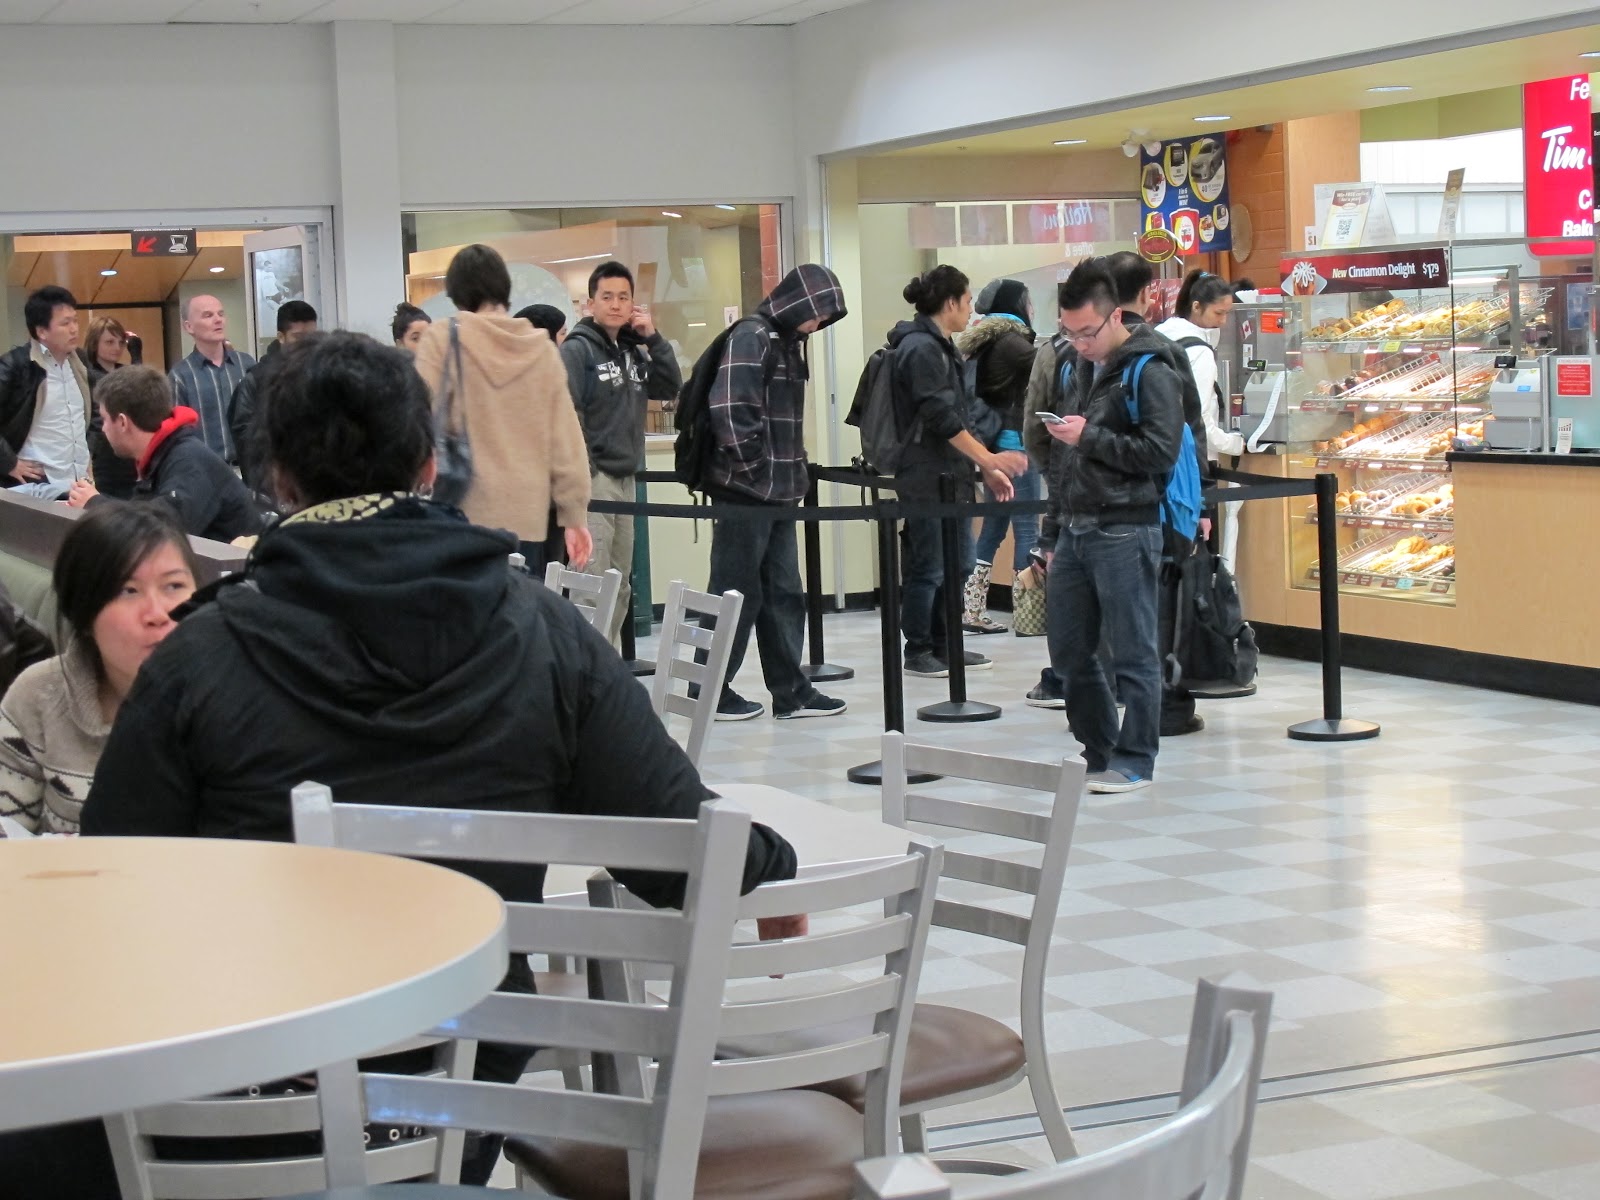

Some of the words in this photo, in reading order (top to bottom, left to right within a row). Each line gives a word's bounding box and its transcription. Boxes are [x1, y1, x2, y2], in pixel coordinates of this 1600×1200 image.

[1541, 125, 1586, 172] Tim
[1578, 189, 1592, 210] C
[1332, 268, 1347, 278] New
[1348, 265, 1387, 278] Cinnamon
[1388, 262, 1416, 279] Delight
